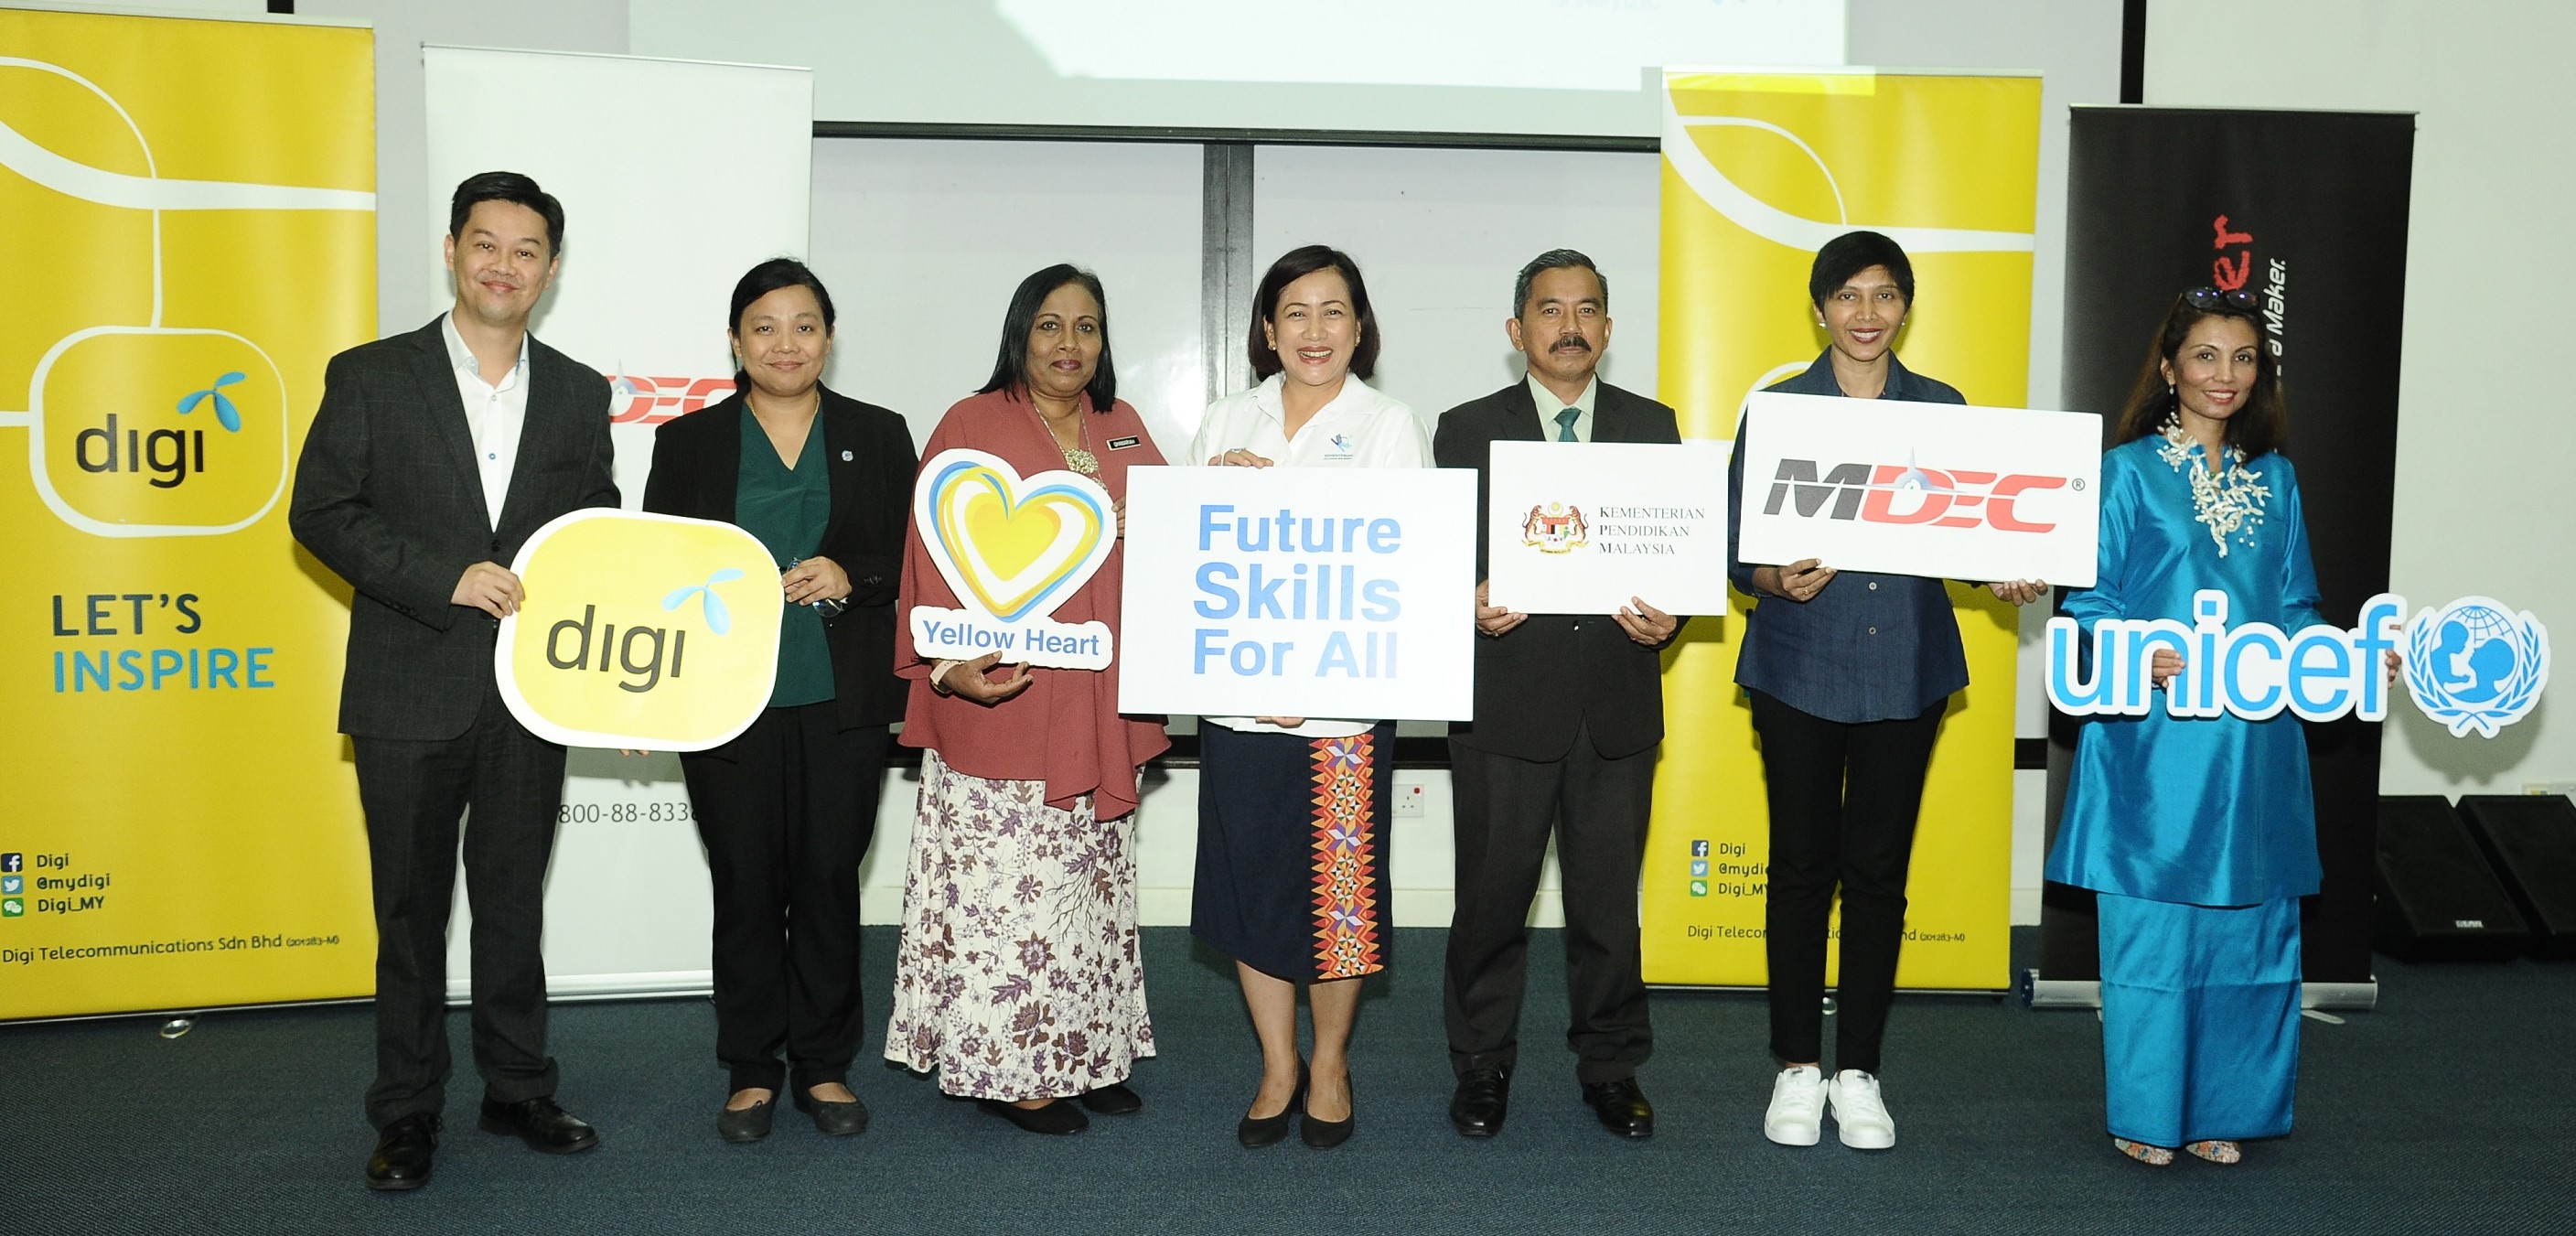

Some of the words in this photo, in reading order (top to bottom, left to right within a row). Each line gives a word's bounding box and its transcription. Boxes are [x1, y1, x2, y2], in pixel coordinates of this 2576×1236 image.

[2213, 214, 2254, 291] er
[2262, 258, 2286, 336] Maker.
[606, 375, 737, 424] DEC
[75, 413, 204, 489] digi
[1198, 504, 1401, 554] Future
[1599, 524, 1690, 537] PENDIDIKAN
[1600, 507, 1705, 519] KEMENTERIAN
[1599, 543, 1675, 555] MALAYSIA
[1193, 561, 1401, 622] Skills
[546, 604, 686, 693] digi
[923, 619, 1015, 650] Yellow
[1025, 628, 1100, 656] Heart
[1194, 629, 1294, 677] For
[1314, 630, 1398, 679] All
[2052, 600, 2398, 715] unicef
[53, 647, 275, 693] INSPIRE
[37, 853, 70, 869] Digi
[1720, 843, 1745, 857] Digi
[37, 874, 111, 891] @mydigi
[38, 896, 105, 913] Digi_MY
[2, 948, 34, 964] Digi
[39, 937, 214, 962] Telecommunications
[218, 936, 247, 951] Sdn
[251, 933, 283, 948] Bhd
[1688, 925, 1712, 940] Digi
